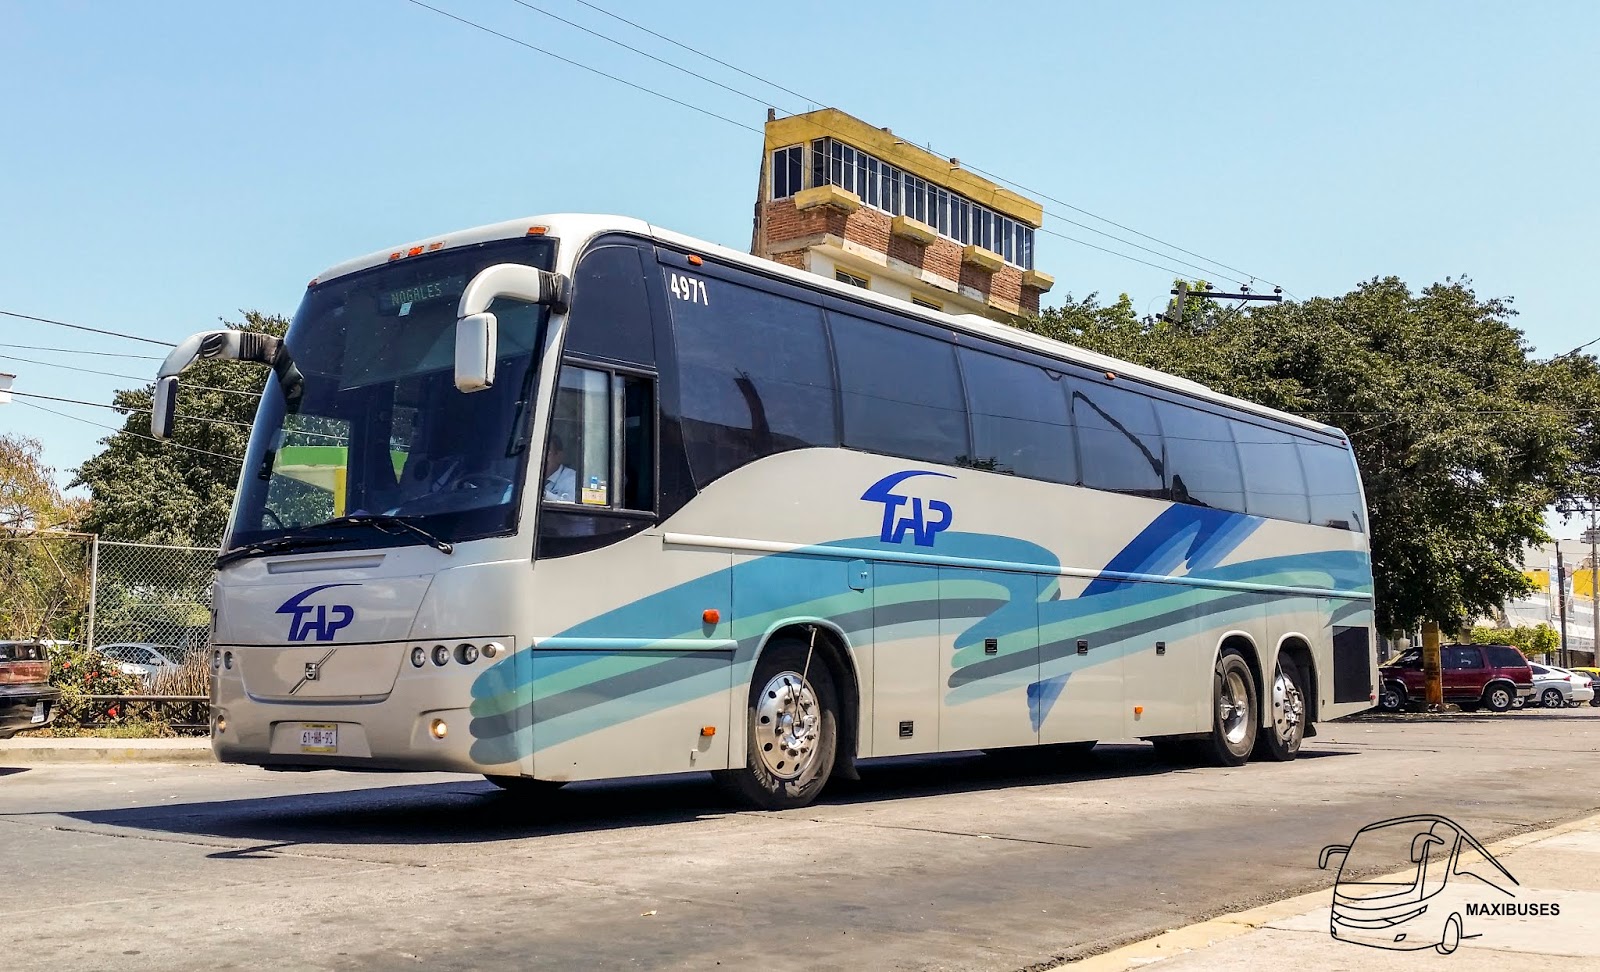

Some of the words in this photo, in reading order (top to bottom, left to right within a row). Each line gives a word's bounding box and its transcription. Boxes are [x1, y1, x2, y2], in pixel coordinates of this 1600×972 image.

[391, 283, 442, 306] NOGALES
[670, 273, 709, 306] 4971
[860, 470, 958, 548] TAP
[275, 583, 363, 642] TAP
